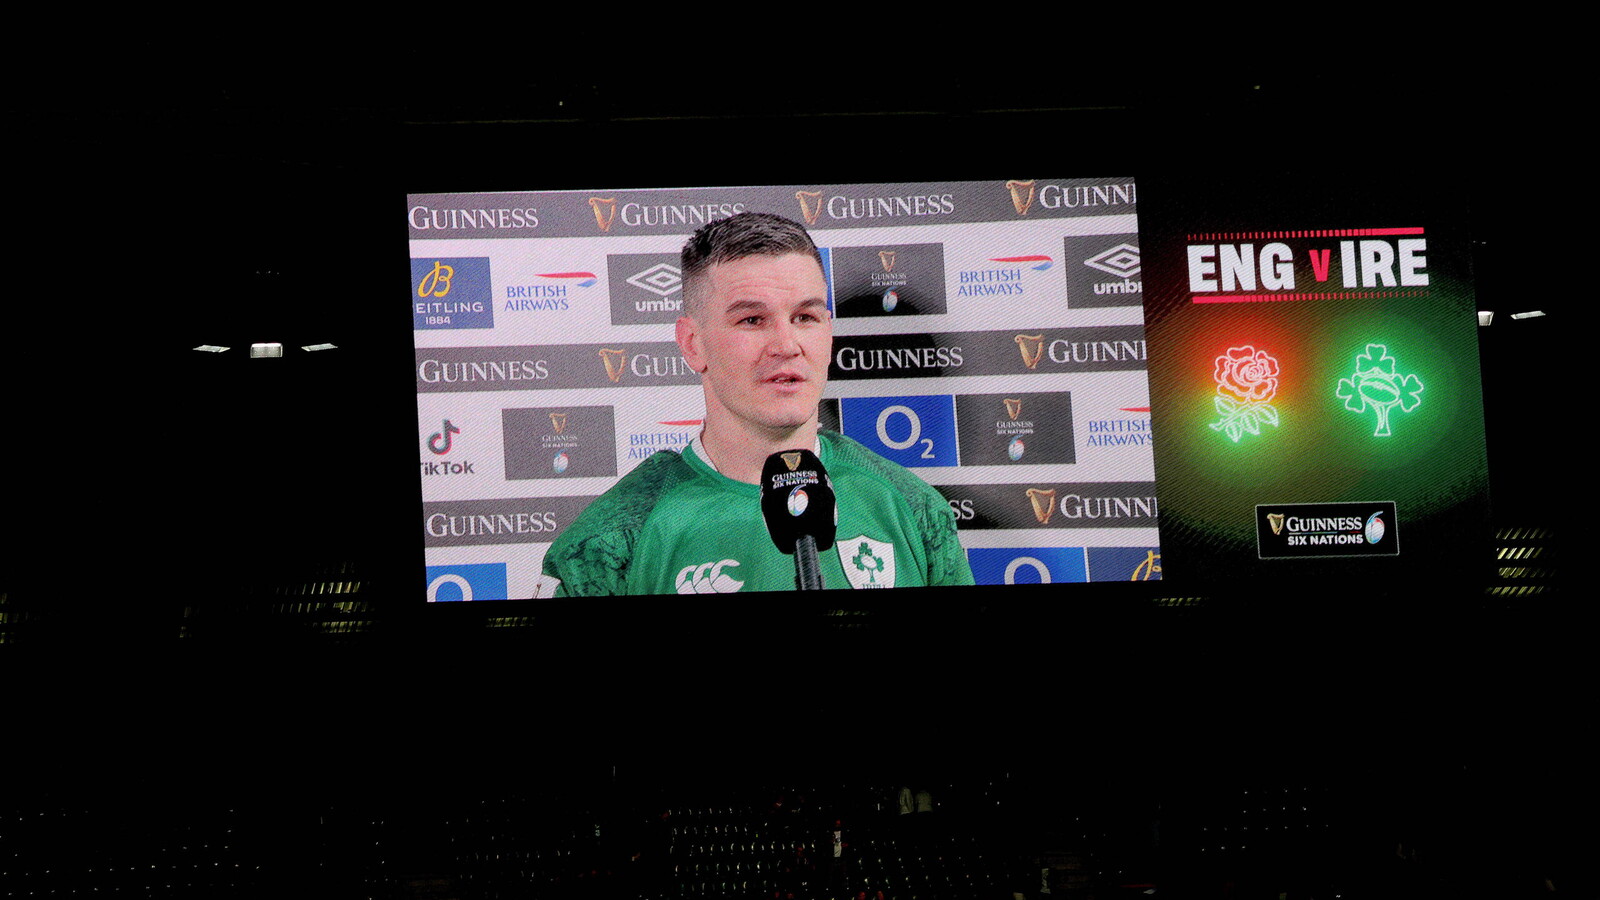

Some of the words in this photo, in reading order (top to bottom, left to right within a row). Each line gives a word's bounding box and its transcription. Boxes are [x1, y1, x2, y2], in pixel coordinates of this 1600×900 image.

[827, 194, 954, 219] GUINNESS
[408, 206, 539, 230] GUINNESS
[1187, 242, 1296, 292] ENG
[1340, 238, 1430, 288] IRE
[959, 269, 1021, 283] BRITISH
[506, 285, 567, 298] BRITISH
[957, 283, 1023, 297] AIRWAYS
[415, 301, 484, 314] EITLING
[504, 298, 569, 311] AIRWAYS
[425, 316, 451, 325] 1884
[836, 347, 964, 371] GUINNESS
[418, 360, 549, 383] GUINNESS
[876, 405, 935, 459] O2
[1089, 419, 1152, 432] BRITISH
[630, 432, 689, 445] BRITISH
[772, 470, 818, 482] GUINNESS
[426, 513, 557, 537] GUINNESS
[1286, 516, 1363, 532] GUINNESS
[1288, 536, 1308, 546] SIX
[1310, 534, 1364, 545] NATIONS
